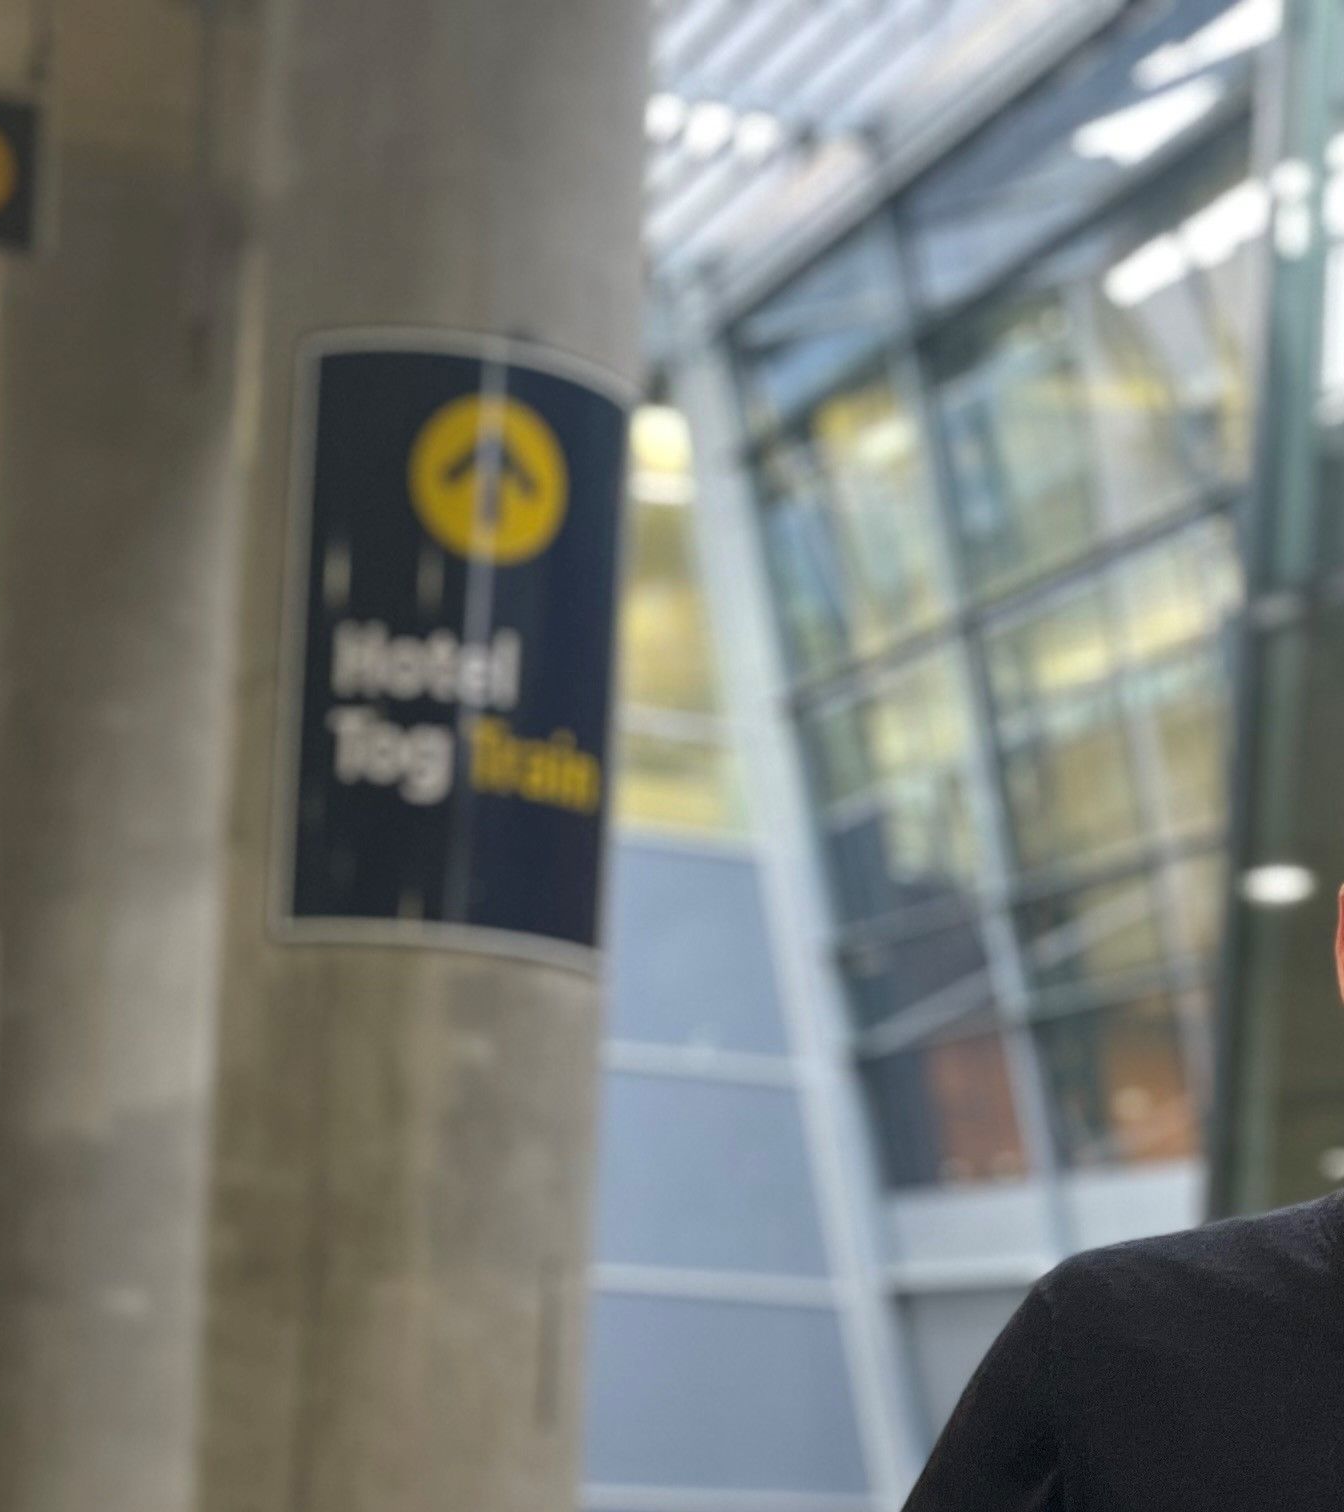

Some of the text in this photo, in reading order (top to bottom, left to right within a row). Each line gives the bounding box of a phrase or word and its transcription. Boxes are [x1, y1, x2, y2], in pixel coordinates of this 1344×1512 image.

[330, 620, 522, 709] Hotel
[326, 705, 602, 815] Tog Train
